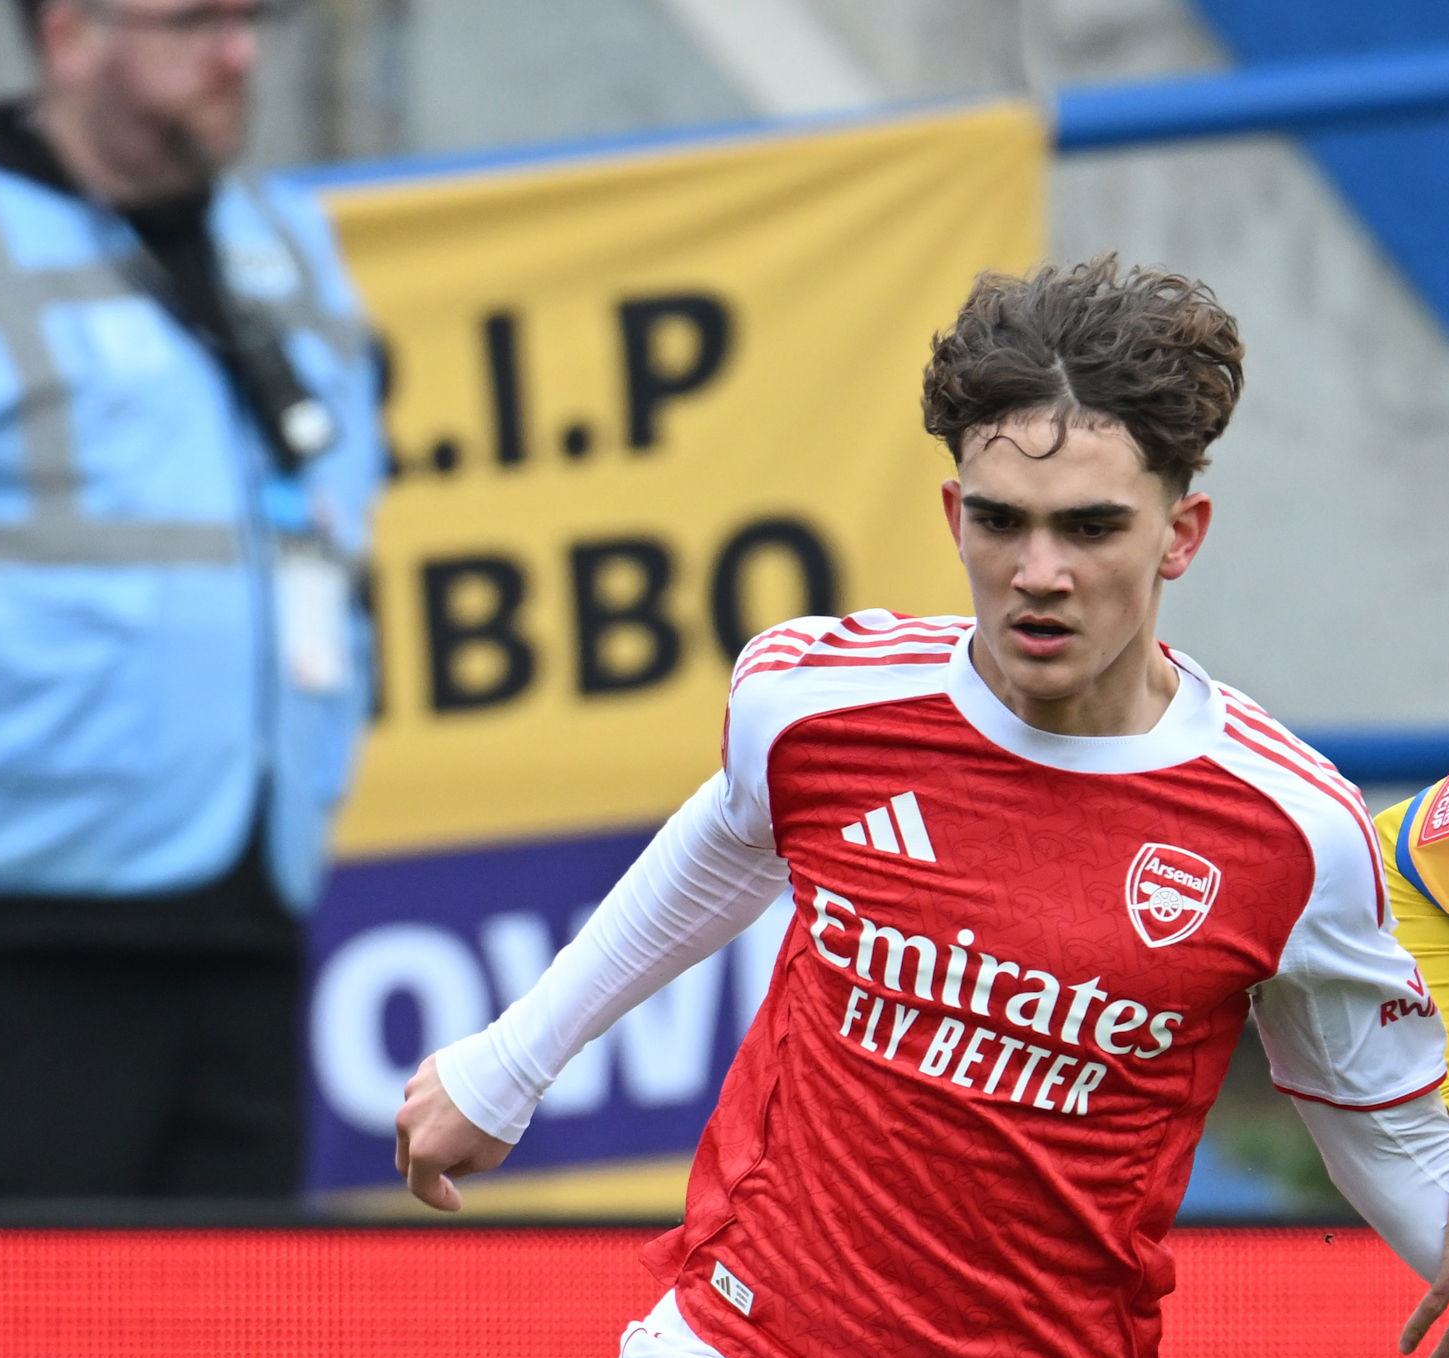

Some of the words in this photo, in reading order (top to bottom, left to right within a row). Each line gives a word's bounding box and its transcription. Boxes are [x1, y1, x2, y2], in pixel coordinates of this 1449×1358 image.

[1431, 798, 1448, 830] CUP
[1144, 857, 1209, 892] Arsenal
[810, 885, 1184, 1060] Emirates
[840, 986, 920, 1060] FLY
[918, 1016, 1108, 1116] BETTER
